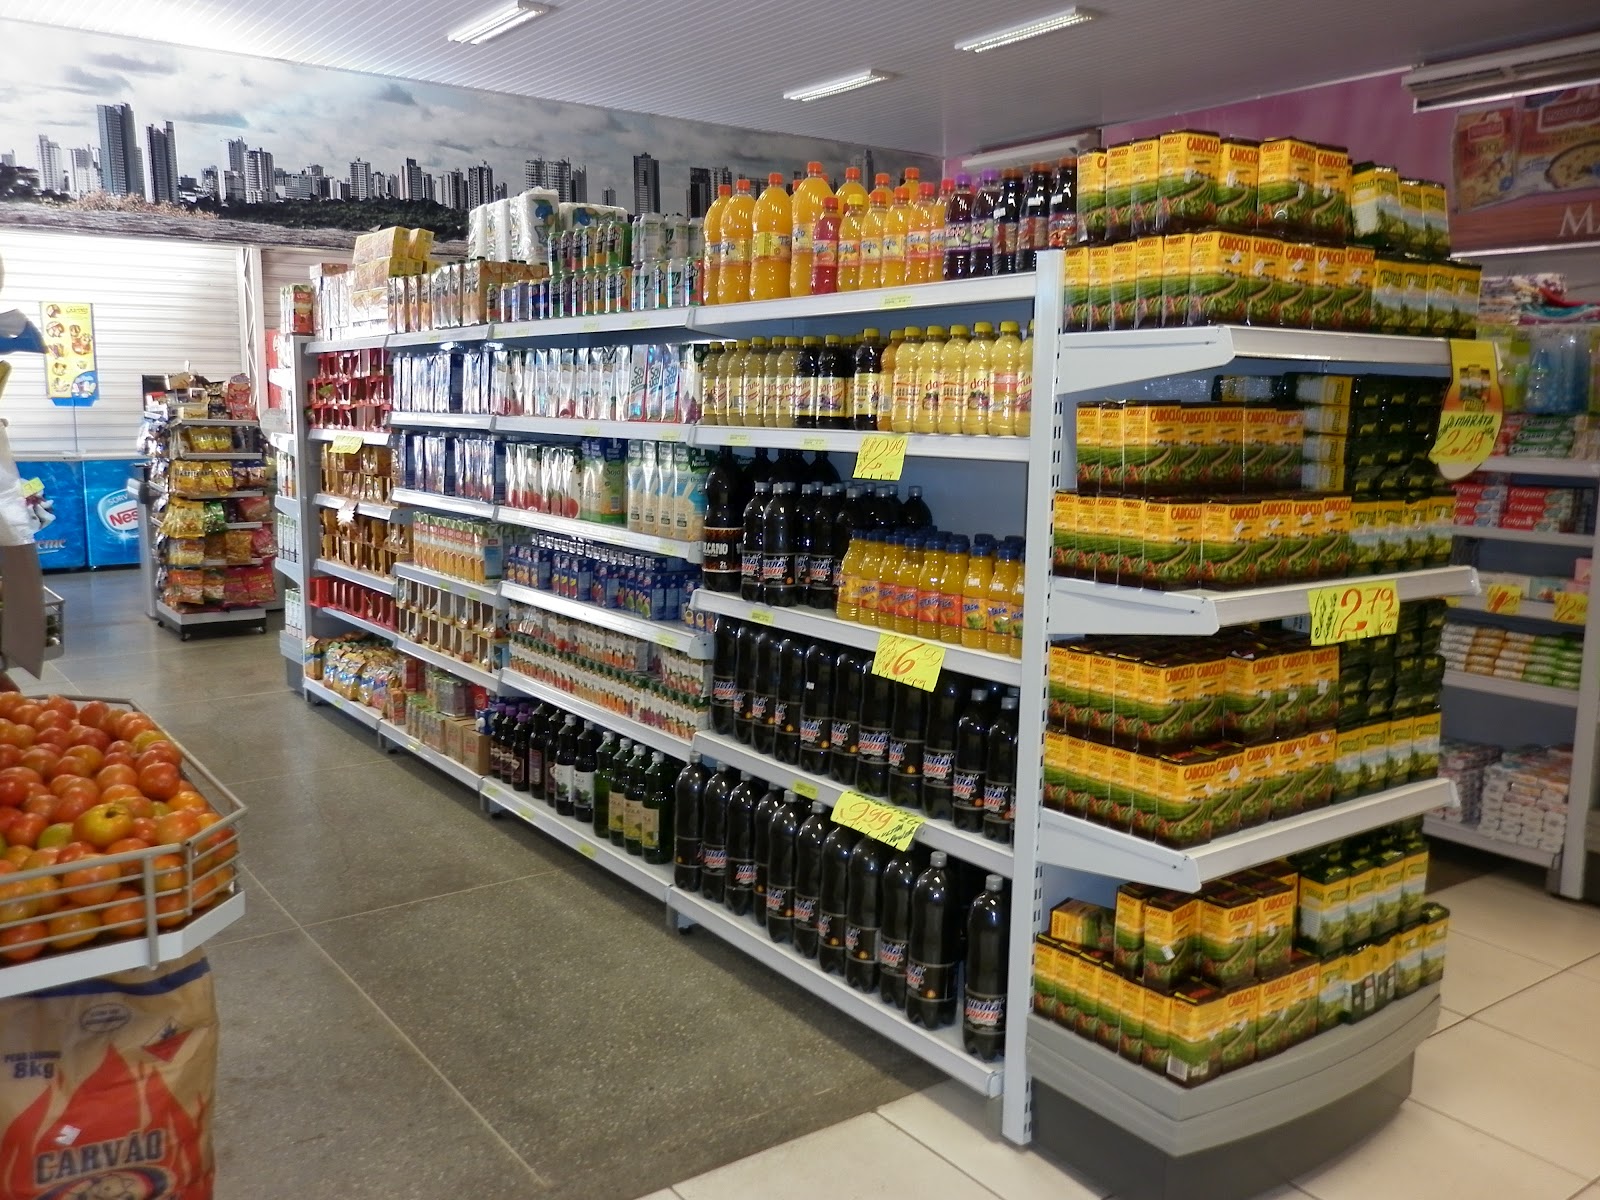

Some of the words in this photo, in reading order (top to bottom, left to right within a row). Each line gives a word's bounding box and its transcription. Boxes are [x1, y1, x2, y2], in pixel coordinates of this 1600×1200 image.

[1187, 136, 1218, 154] CABOCLO
[1230, 146, 1258, 163] CABOCLO
[1318, 153, 1346, 168] CABOCLO
[1218, 235, 1250, 252] CABOCLO
[1254, 239, 1283, 254] CABOCLO
[1285, 246, 1315, 260] CABOCLO
[1151, 409, 1180, 423] CABOCLO
[1182, 411, 1211, 424] CABOCLO
[1214, 410, 1242, 422] CABOCLO
[1247, 411, 1276, 423] CABOCLO
[108, 494, 128, 504] SORV
[1510, 488, 1545, 498] Colgate
[1262, 503, 1291, 515] CABOCLO
[1294, 503, 1322, 515] CABOCLO
[1324, 499, 1350, 511] CABOCLO
[1509, 503, 1544, 512] Colgate
[109, 508, 138, 526] Nes
[1171, 507, 1201, 520] CABOCLO
[1230, 507, 1260, 520] CABOCLO
[38, 539, 67, 550] eme
[703, 543, 728, 555] LCANO
[1282, 652, 1308, 667] CABOCLO
[1312, 648, 1337, 664] CABOCLO
[1197, 663, 1225, 678] CABOCLO
[1253, 658, 1279, 674] CABOCLO
[1165, 666, 1195, 682] CABOCLO
[1247, 746, 1275, 762] CABOCLO
[1216, 755, 1244, 772] CABOCLO
[1184, 763, 1216, 780] CABOCLO
[1263, 893, 1291, 911] CABOCLO
[1172, 902, 1198, 925] CABOCLO
[1229, 905, 1257, 923] CABOCLO
[1264, 977, 1291, 997] CABOCLO
[1228, 986, 1259, 1008] CABOCLO
[36, 1129, 163, 1185] CARVÃO
